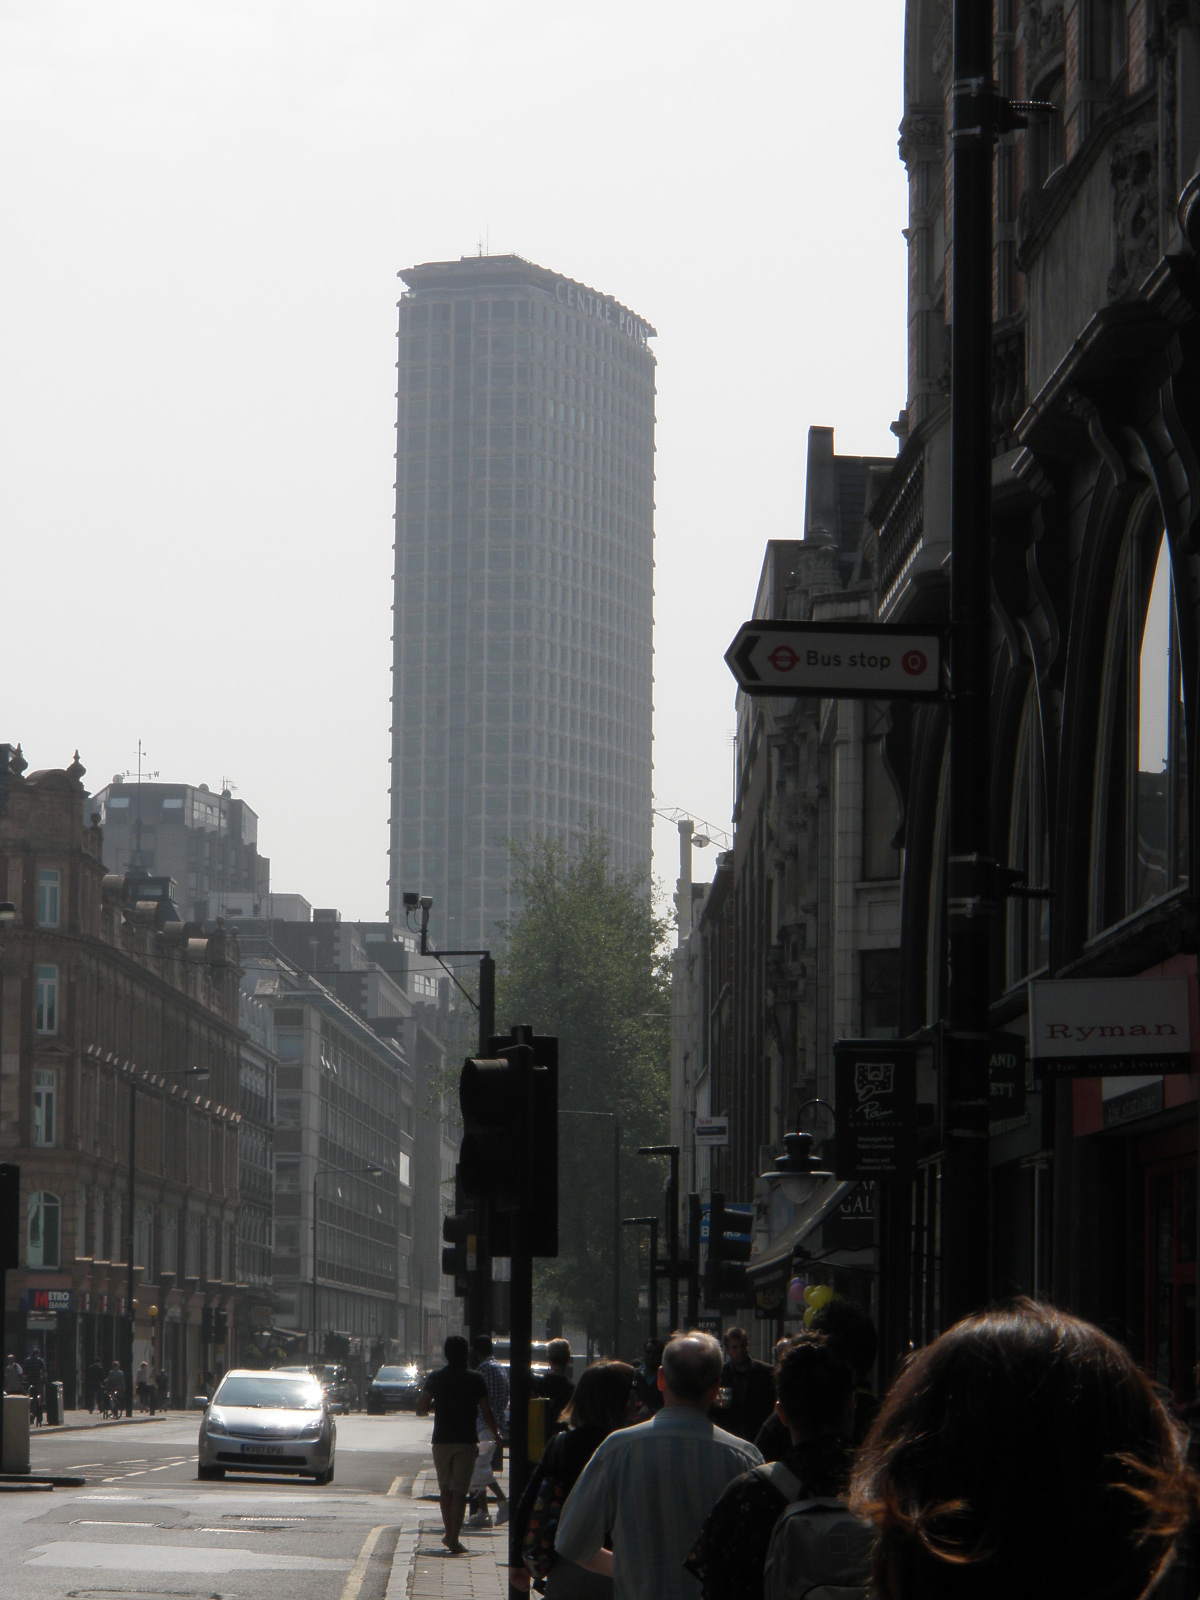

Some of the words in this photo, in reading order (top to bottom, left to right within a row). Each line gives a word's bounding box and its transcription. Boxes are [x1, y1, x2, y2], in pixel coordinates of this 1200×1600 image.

[555, 281, 611, 325] CENTRE
[619, 311, 649, 347] POINT
[806, 650, 842, 667] Bus
[849, 652, 891, 671] stop
[1046, 1023, 1178, 1042] Ryman
[1047, 1062, 1077, 1073] the
[1087, 1060, 1181, 1071] stationer
[855, 1101, 894, 1121] Pain
[35, 1290, 70, 1309] METRO
[48, 1301, 70, 1310] BANK
